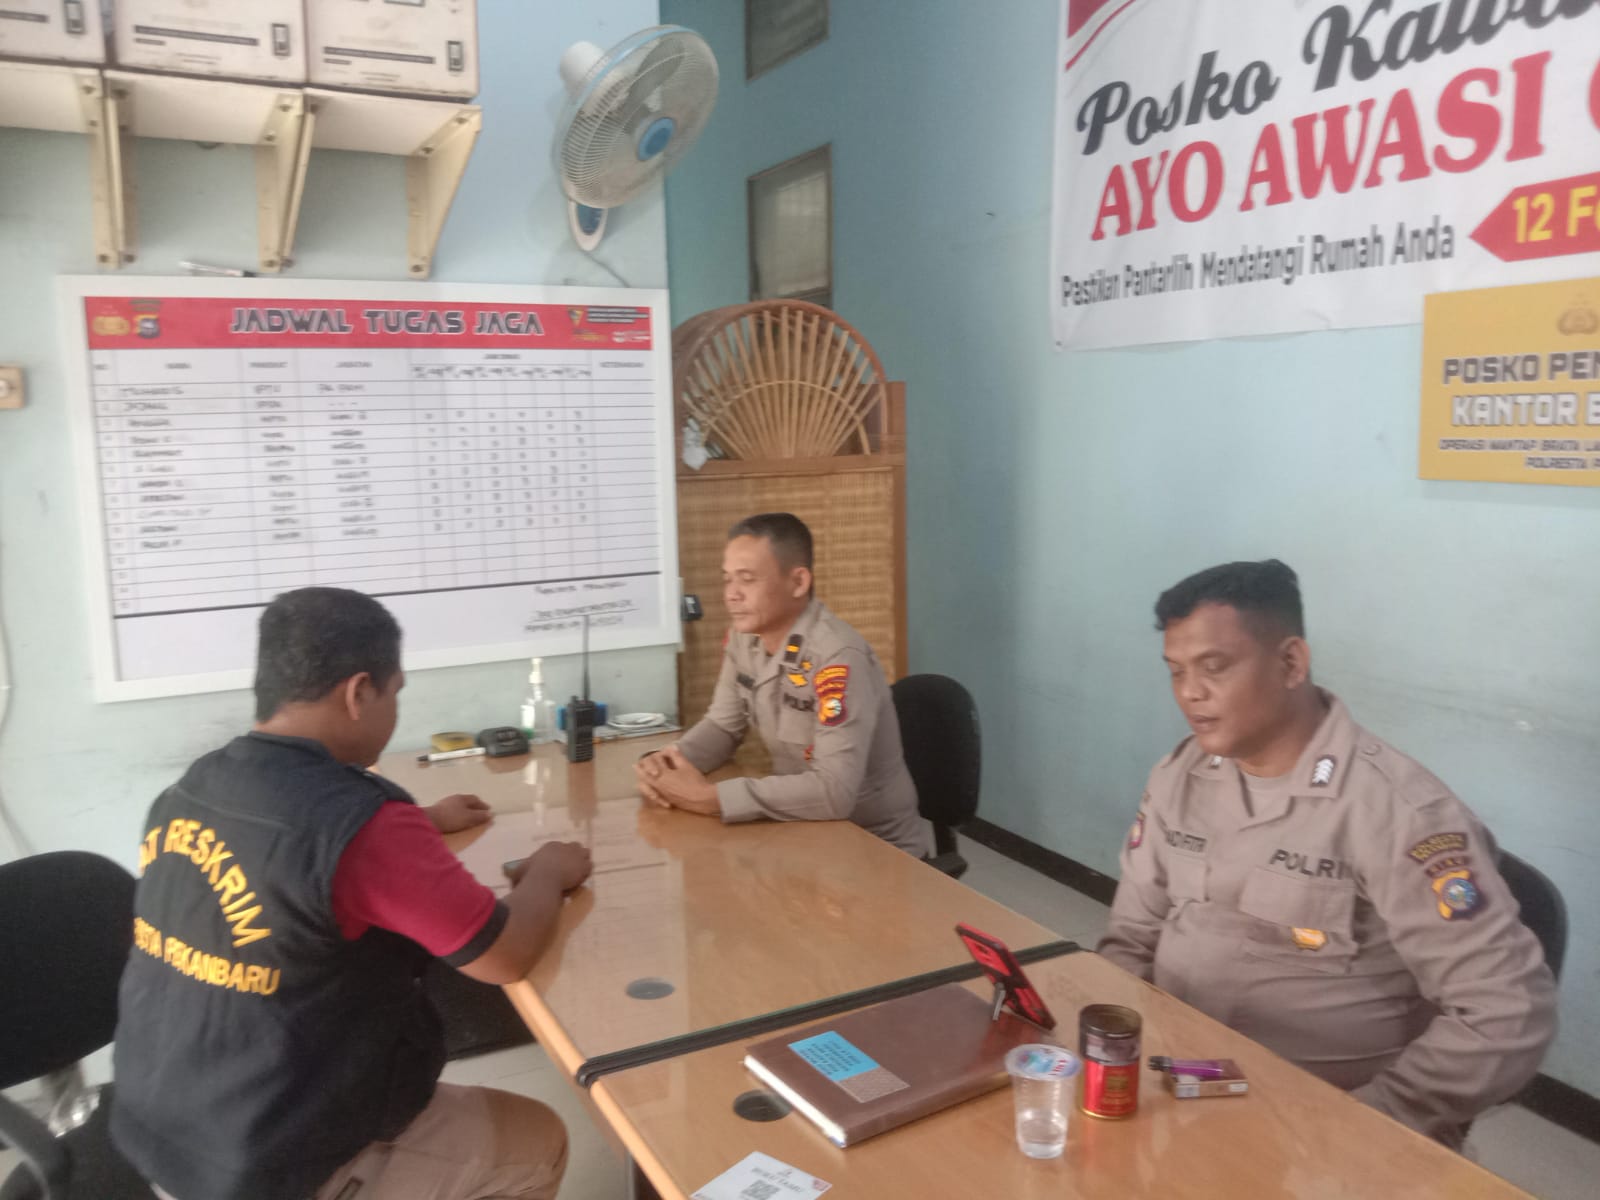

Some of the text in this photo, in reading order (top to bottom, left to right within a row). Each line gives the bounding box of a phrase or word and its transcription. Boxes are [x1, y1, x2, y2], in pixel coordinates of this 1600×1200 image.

[1077, 50, 1281, 156] Posko
[1091, 140, 1224, 241] AYO
[1239, 50, 1552, 212] AWASI
[1513, 185, 1600, 243] 12 F
[1201, 236, 1304, 284] Mendatangi
[1311, 224, 1384, 274] Rumah
[1390, 214, 1454, 265] Anda
[230, 308, 353, 334] JADWAL
[363, 309, 465, 335] TUGAS
[473, 311, 545, 336] JAGA
[1442, 354, 1539, 384] POSKO
[1452, 392, 1577, 427] KANTOR
[163, 819, 272, 948] RESKRIM
[1269, 848, 1342, 881] POLRI
[163, 937, 281, 996] PEKANBARU
